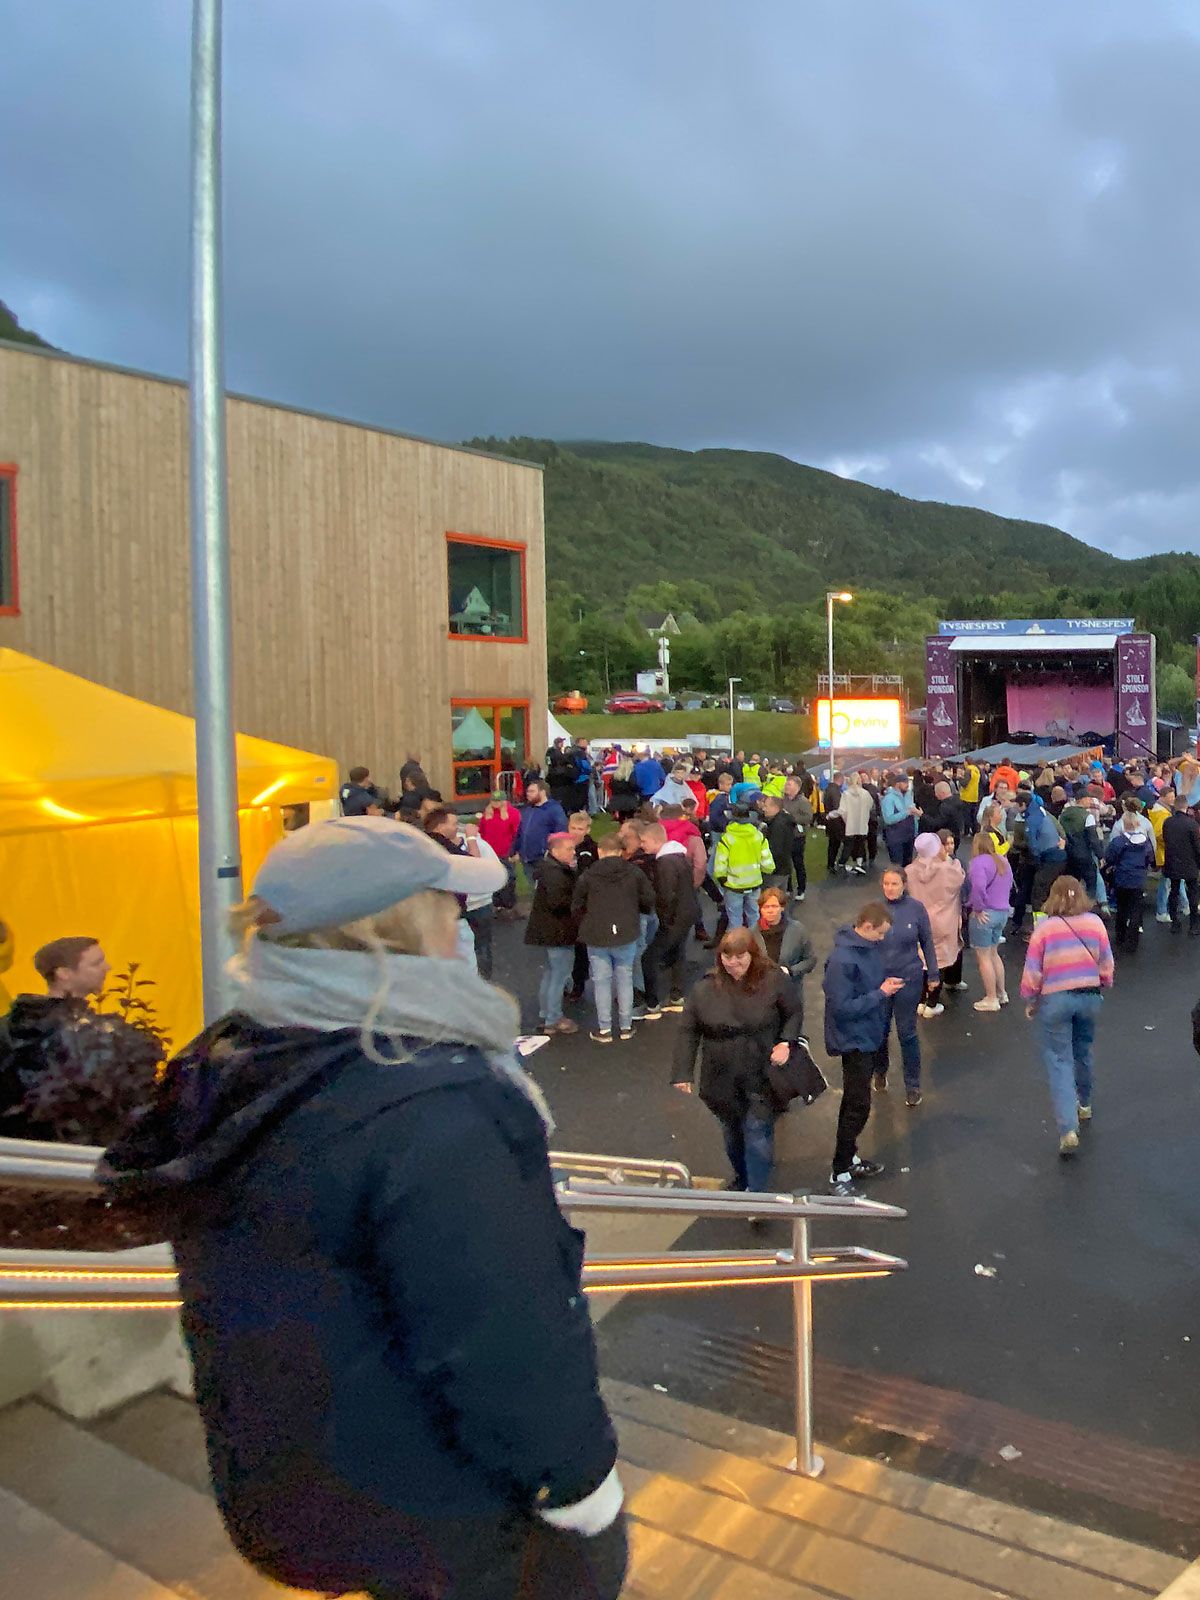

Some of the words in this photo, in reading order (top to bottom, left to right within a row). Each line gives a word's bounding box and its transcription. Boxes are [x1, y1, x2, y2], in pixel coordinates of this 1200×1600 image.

[941, 622, 1006, 630] TYSNESFEST
[1067, 620, 1132, 628] TYSNESFEST
[931, 675, 949, 685] STOLT
[1125, 674, 1145, 684] STOLT
[927, 684, 955, 694] SPONSOR
[1121, 683, 1149, 694] SPONSOR
